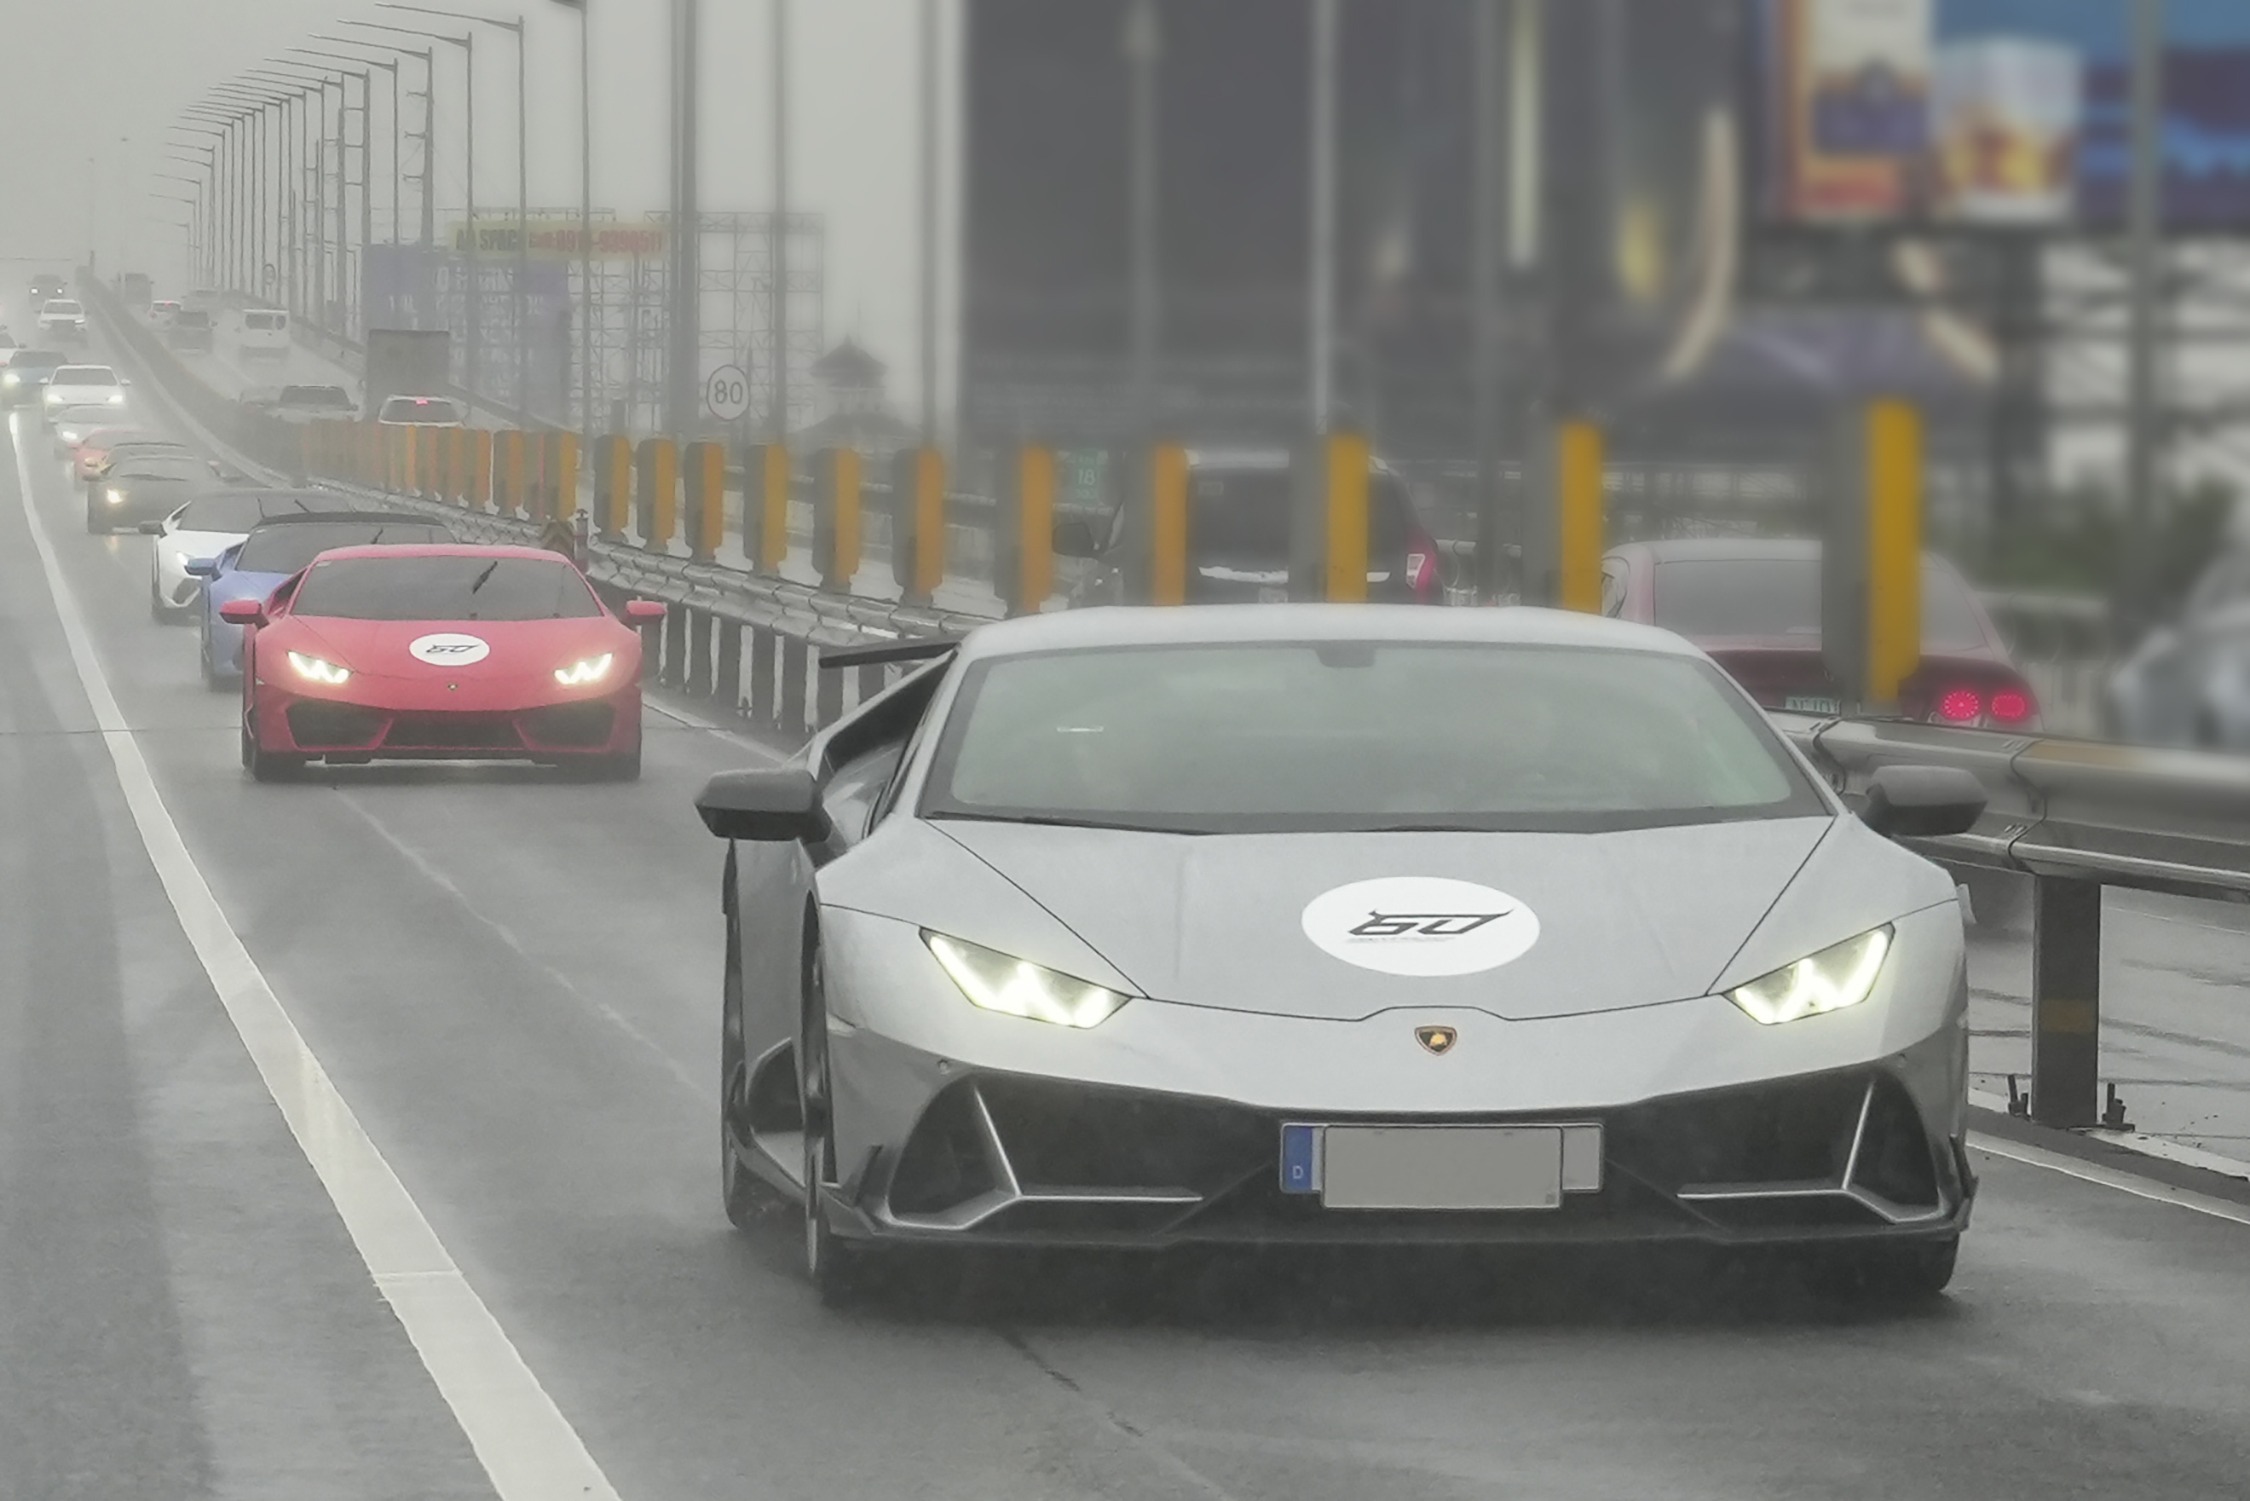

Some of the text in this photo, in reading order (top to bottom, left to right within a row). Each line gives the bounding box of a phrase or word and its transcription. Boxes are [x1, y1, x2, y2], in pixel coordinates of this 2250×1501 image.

[714, 379, 743, 404] 80
[1078, 468, 1096, 486] 18
[1292, 1165, 1304, 1180] D
